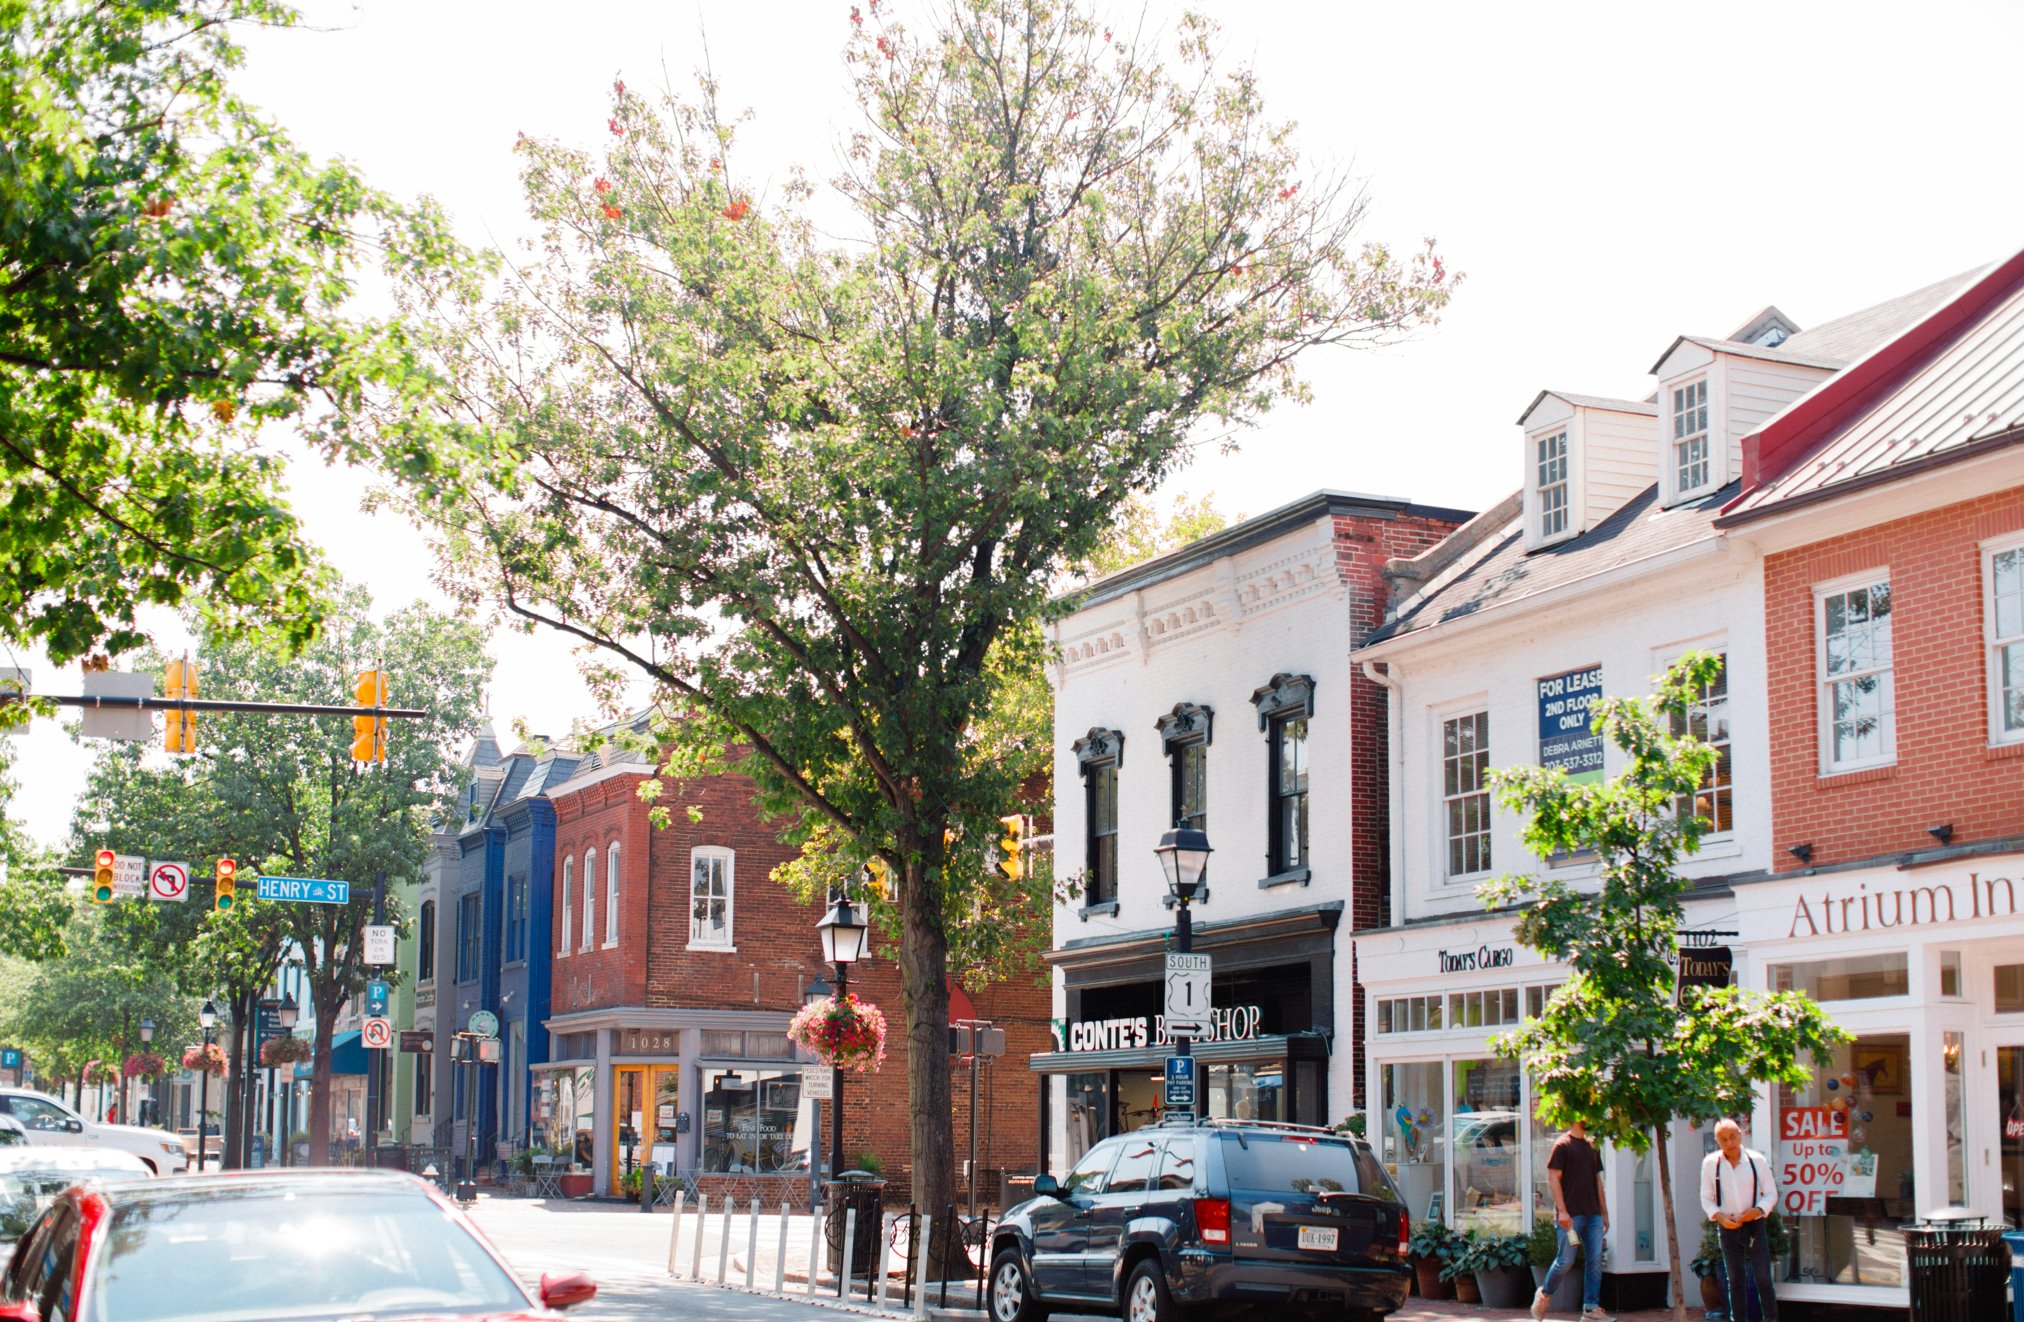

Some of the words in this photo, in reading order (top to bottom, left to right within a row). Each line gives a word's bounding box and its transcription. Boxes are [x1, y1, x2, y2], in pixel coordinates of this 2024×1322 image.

[1540, 679, 1564, 699] FOR
[1566, 669, 1602, 693] LEASE
[1545, 701, 1564, 717] 2ND
[1559, 712, 1585, 730] ONLY
[1543, 743, 1569, 757] DEBRA
[114, 861, 124, 870] DO
[128, 862, 142, 871] NOT
[114, 873, 140, 883] BLOCK
[259, 880, 311, 899] HENRY
[327, 884, 346, 900] ST
[1789, 883, 1955, 938] Atrium
[1969, 873, 2024, 917] In
[1170, 956, 1207, 968] SOUTH
[1439, 950, 1475, 973] TODAY'S
[1478, 944, 1512, 969] CARGO
[1680, 957, 1730, 976] TODAY'S
[373, 986, 382, 998] P
[1185, 981, 1192, 1006] 1
[1071, 1017, 1147, 1051] CONTE'S
[631, 1037, 670, 1049] 1028
[6, 1052, 15, 1064] P
[1176, 1060, 1185, 1073] P
[760, 1123, 776, 1132] FOOD
[1786, 1111, 1844, 1137] SALE
[1793, 1143, 1814, 1159] Up
[1782, 1163, 1844, 1186] 50%
[1311, 1205, 1332, 1215] Jeep
